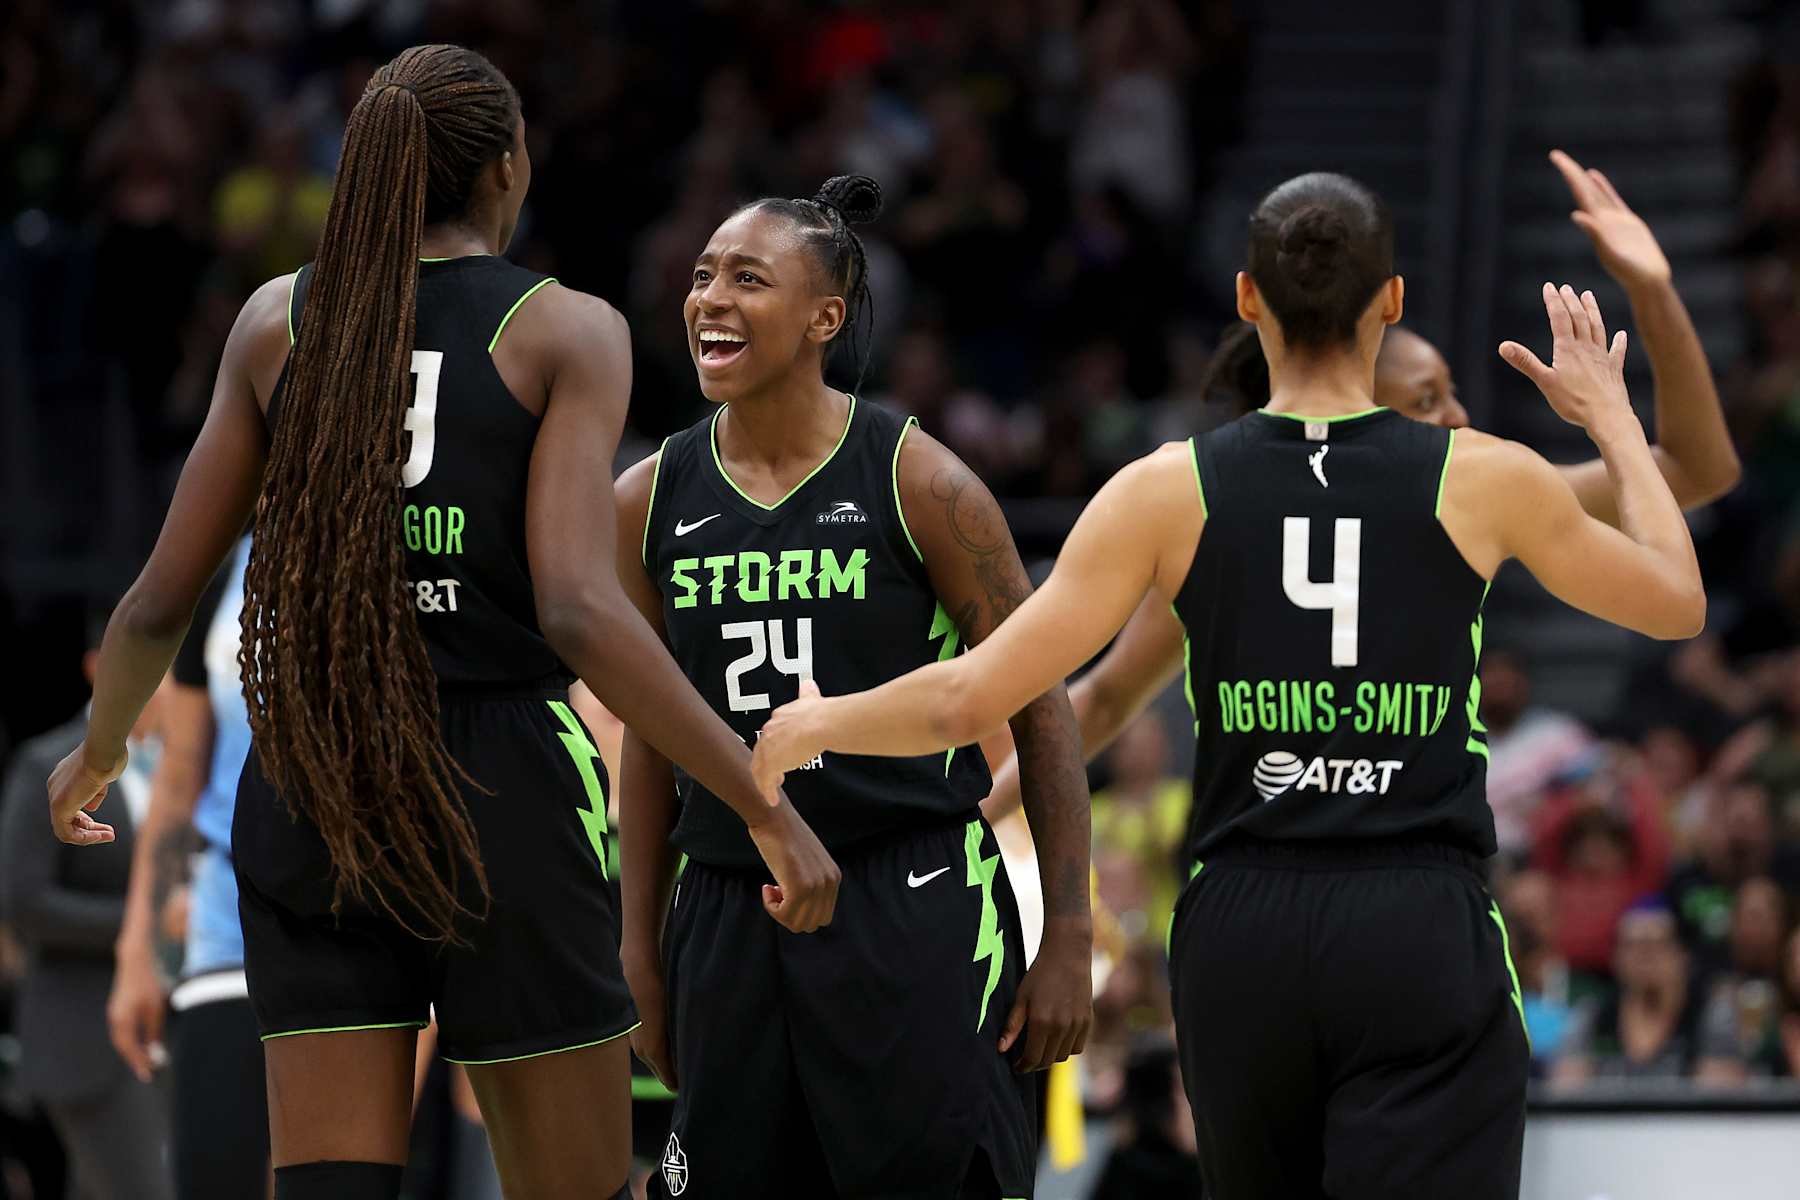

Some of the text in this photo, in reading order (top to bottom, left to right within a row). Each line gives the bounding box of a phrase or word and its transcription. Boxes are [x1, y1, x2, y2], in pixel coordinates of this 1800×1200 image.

[404, 505, 465, 554] GOR
[818, 515, 866, 523] SYMETRA
[408, 579, 461, 613] &T
[671, 549, 870, 609] STORM
[1282, 516, 1361, 667] 4
[721, 617, 813, 711] 24
[1296, 756, 1403, 795] AT&T
